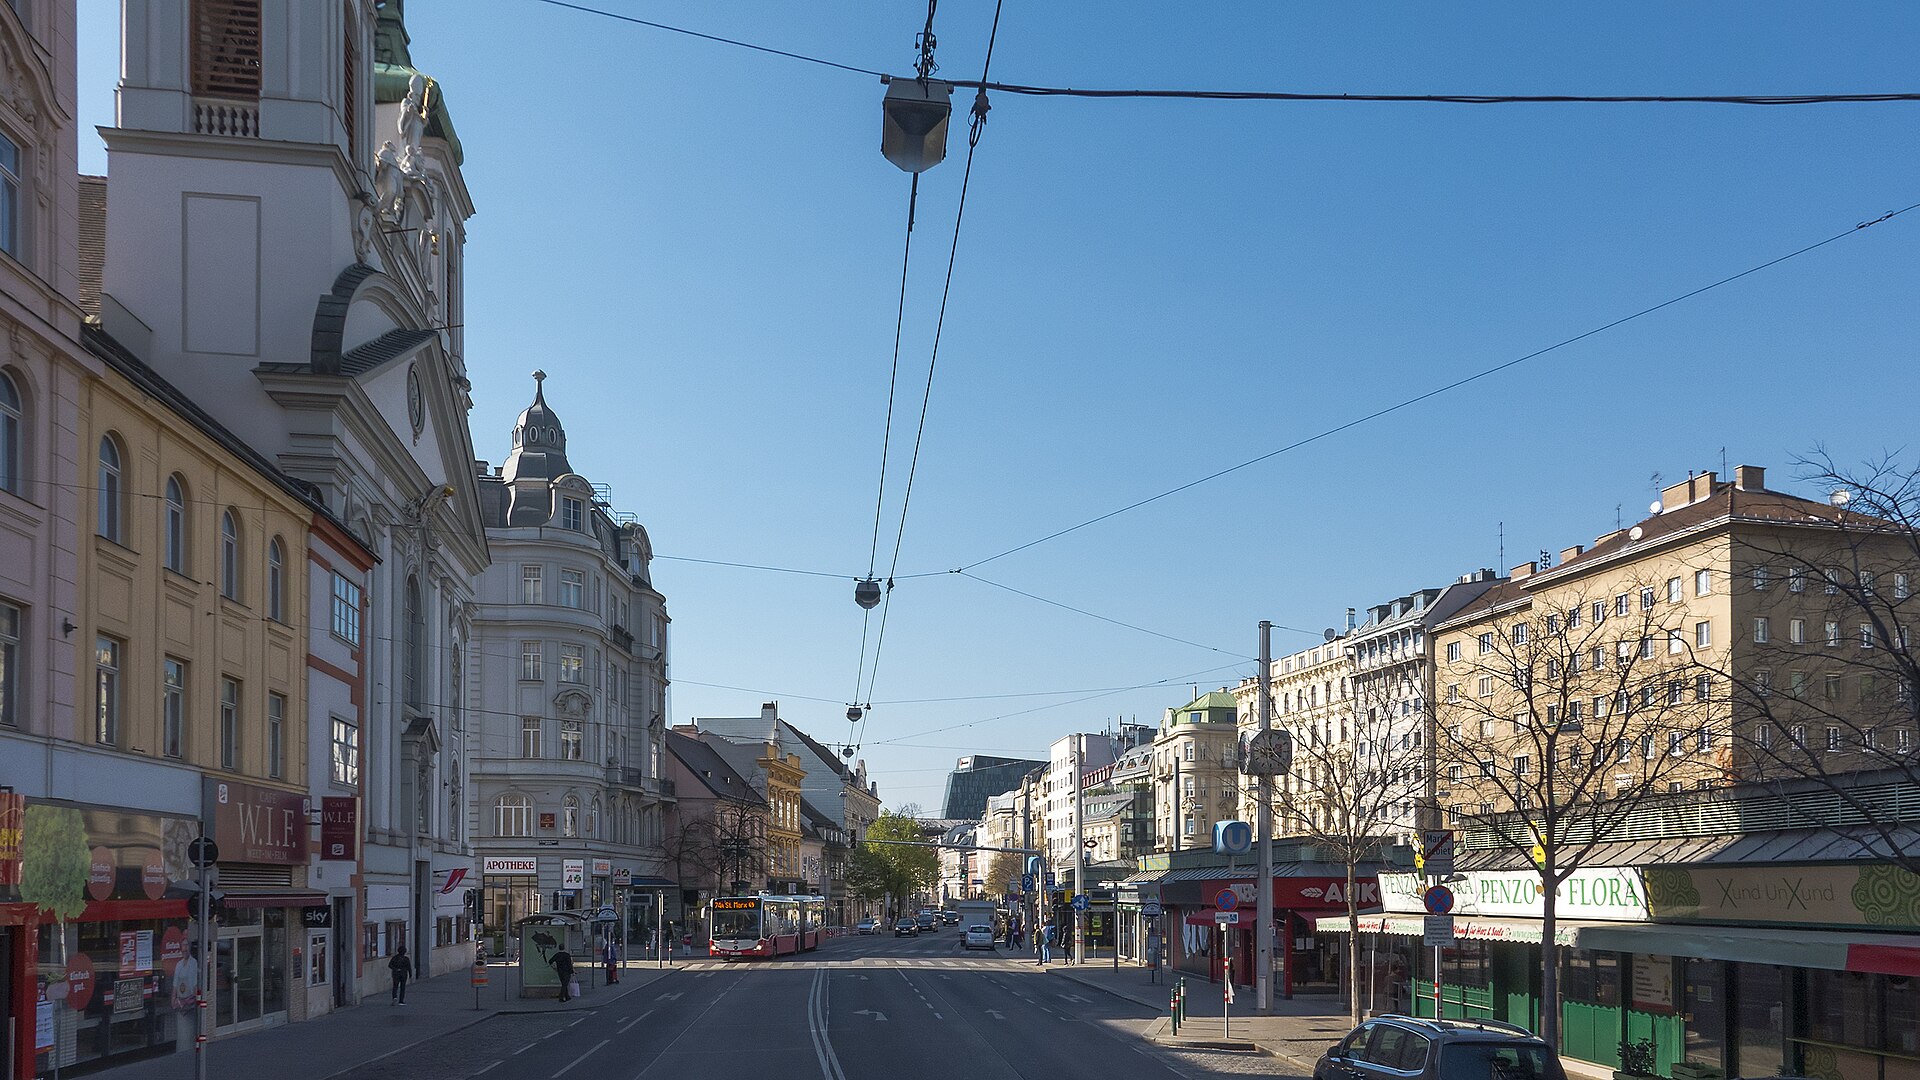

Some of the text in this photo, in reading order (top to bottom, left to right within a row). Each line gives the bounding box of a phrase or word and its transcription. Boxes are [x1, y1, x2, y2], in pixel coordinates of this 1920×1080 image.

[324, 811, 356, 824] W.I.F.
[237, 802, 296, 848] W.I.F.
[1227, 829, 1247, 849] U
[486, 861, 535, 870] APOTHEKE
[1481, 878, 1640, 906] PENZO FLORA
[1716, 878, 1834, 910] Xund UnXund
[733, 901, 748, 909] Marx
[306, 910, 328, 923] sky
[70, 971, 90, 981] Einfach
